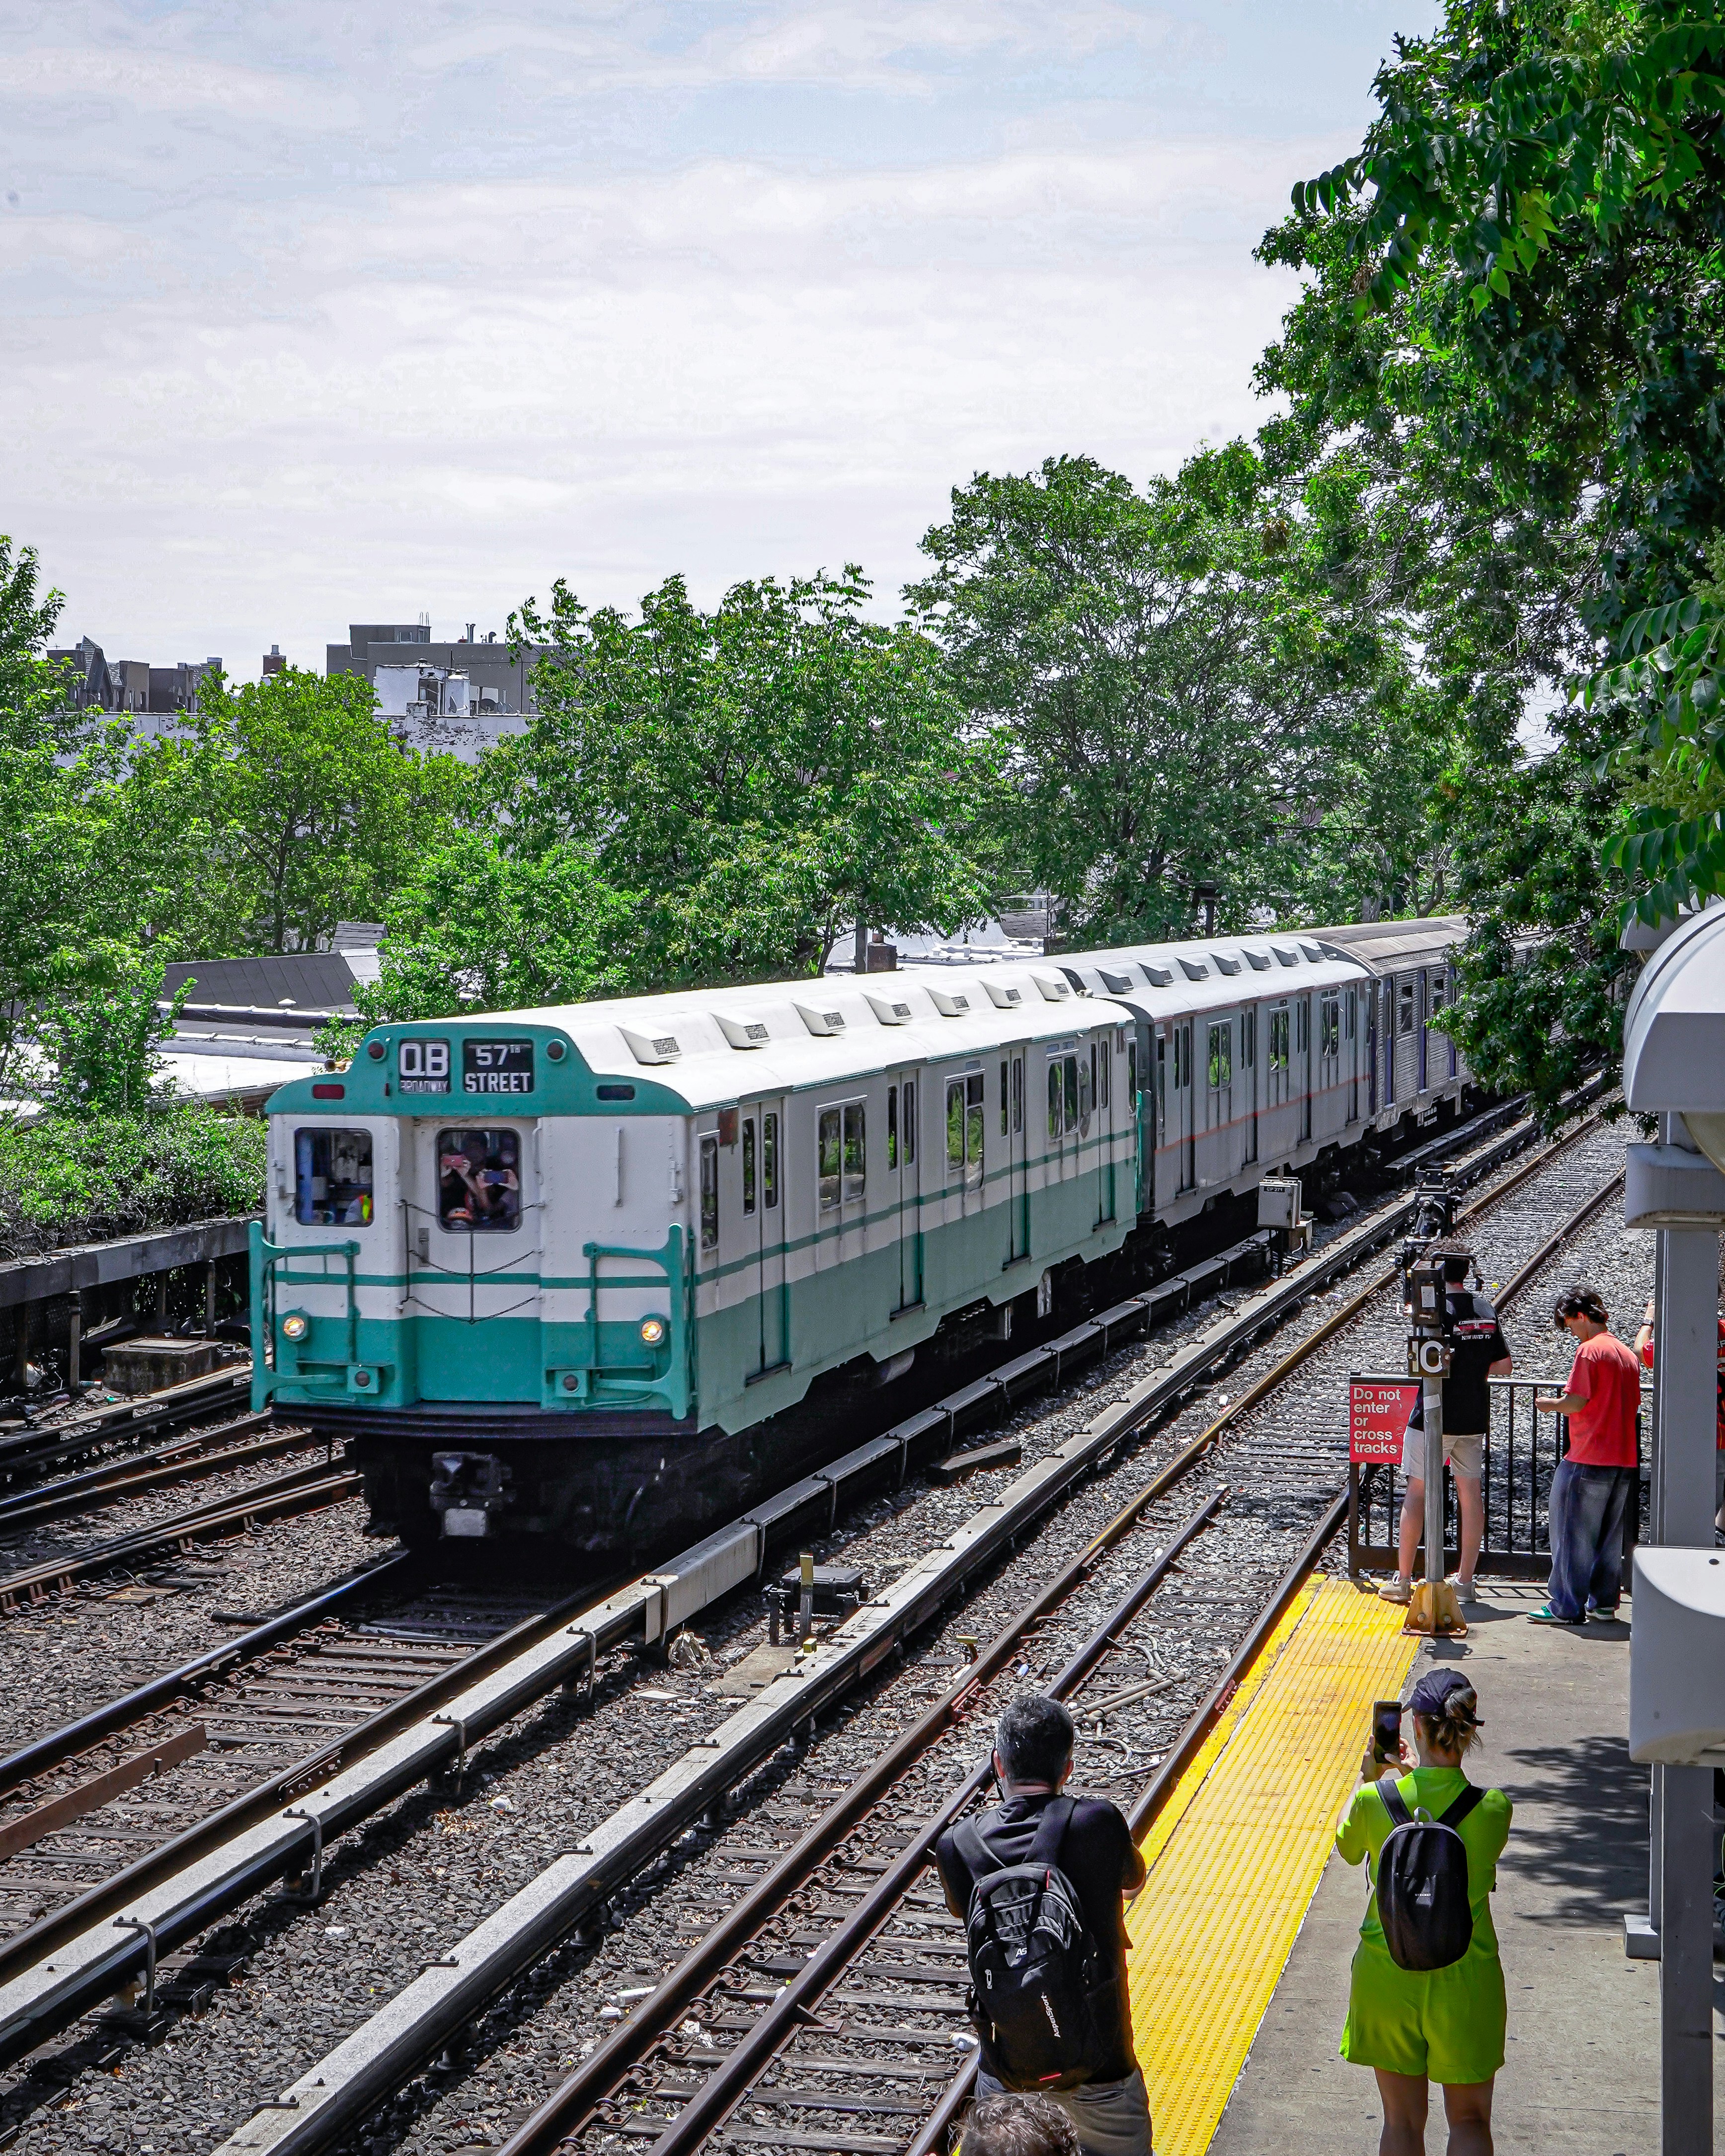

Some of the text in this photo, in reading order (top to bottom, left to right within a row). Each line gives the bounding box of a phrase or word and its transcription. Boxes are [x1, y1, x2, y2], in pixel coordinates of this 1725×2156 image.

[399, 1043, 449, 1077] QB
[465, 1073, 531, 1092] STREET
[1412, 1340, 1444, 1373] 10
[1354, 1387, 1401, 1400] Do not
[1354, 1402, 1390, 1413] enter
[1354, 1417, 1368, 1426] or
[1354, 1430, 1393, 1440] cross
[1354, 1441, 1398, 1455] tracks
[1015, 1947, 1027, 1958] AS
[1040, 1992, 1061, 2038] AspenSport
